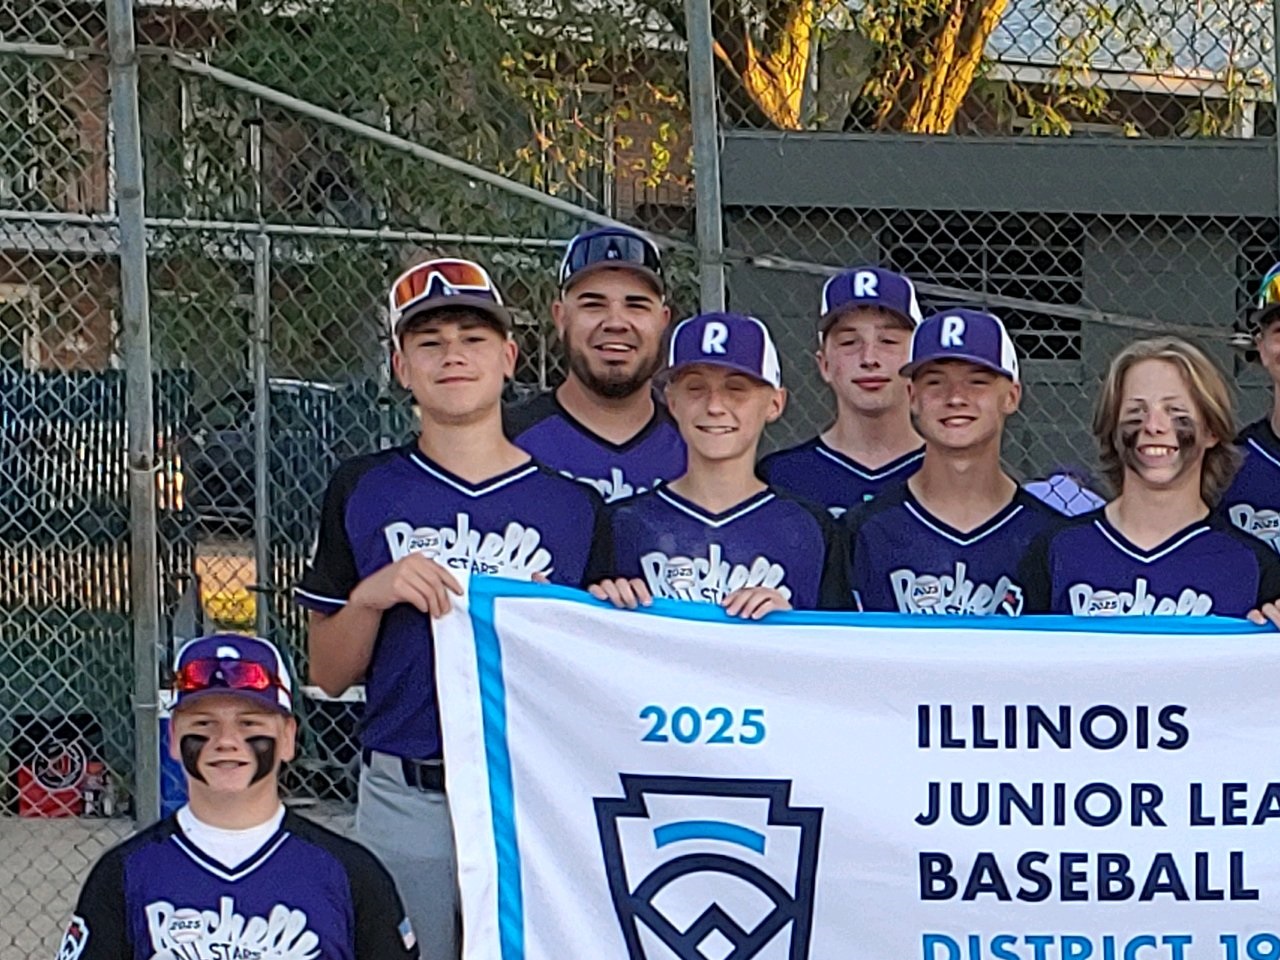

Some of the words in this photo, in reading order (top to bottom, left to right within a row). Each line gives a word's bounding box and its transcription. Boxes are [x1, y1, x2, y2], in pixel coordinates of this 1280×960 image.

[853, 271, 879, 297] R
[702, 322, 729, 354] R
[941, 316, 966, 346] R
[639, 705, 766, 745] 2025
[916, 704, 1190, 751] ILLINOIS
[914, 781, 1167, 828] JUNIOR
[918, 851, 1260, 903] BASEBALL
[145, 896, 322, 955] Rochelle
[169, 920, 202, 931] 2025
[208, 942, 263, 960] STARS
